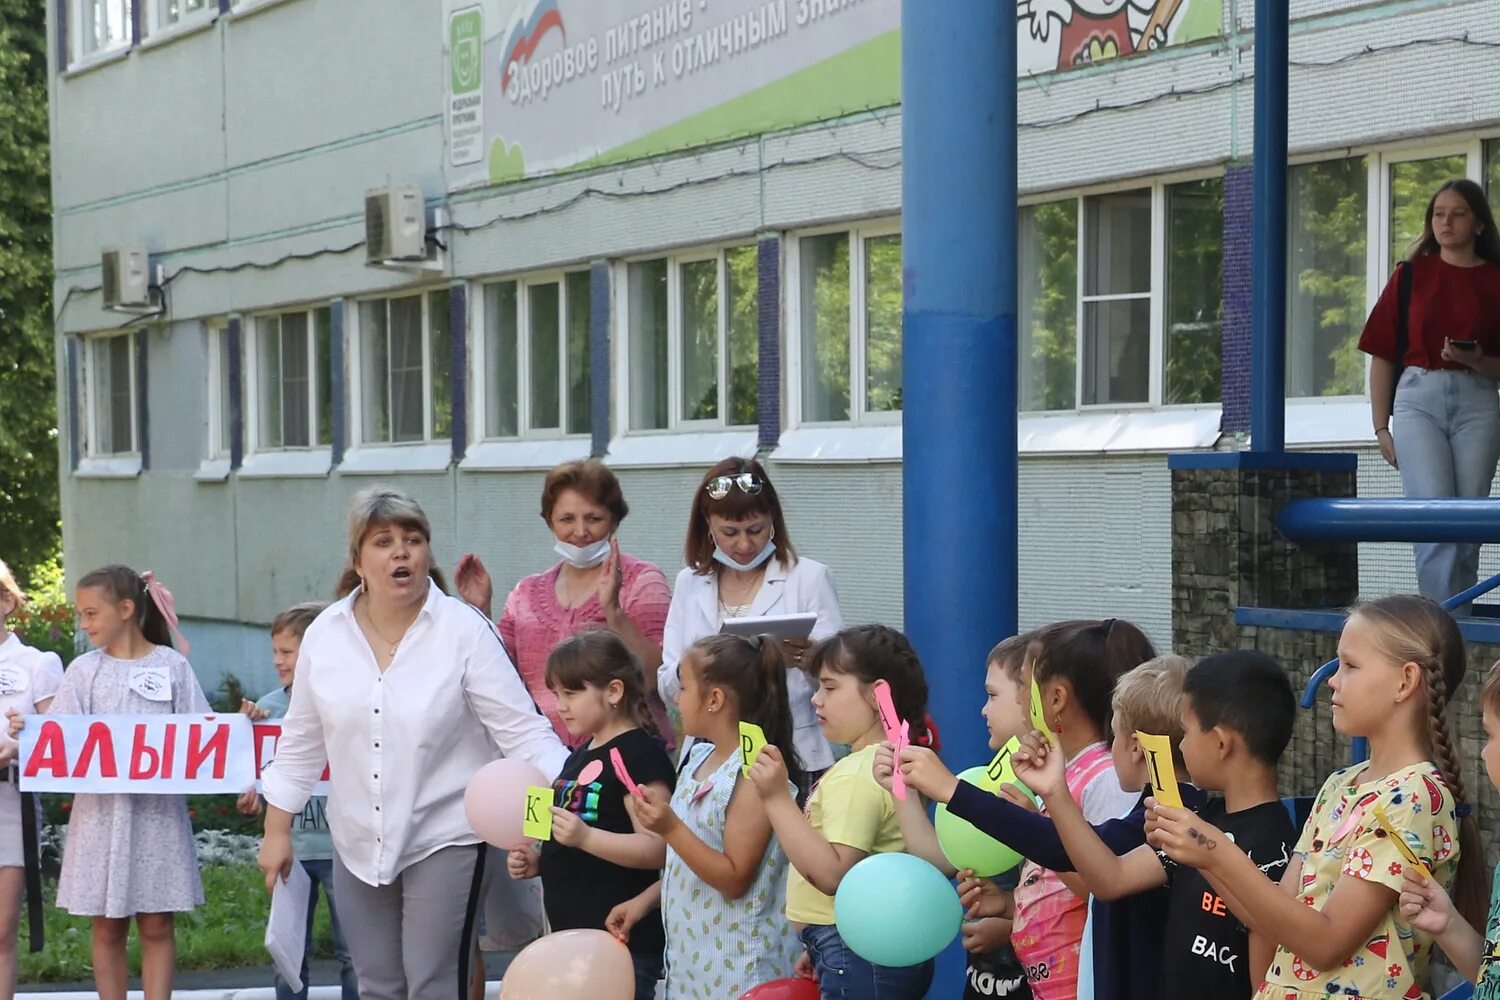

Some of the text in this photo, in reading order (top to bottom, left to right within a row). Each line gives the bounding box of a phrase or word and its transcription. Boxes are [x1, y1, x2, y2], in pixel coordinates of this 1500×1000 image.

[507, 37, 599, 104] Здоровое
[606, 0, 692, 62] питание
[601, 61, 646, 113] путь
[672, 0, 788, 77] отличным
[23, 716, 230, 780] АЛЫЙ
[741, 734, 754, 766] Р
[525, 795, 541, 823] К
[1191, 935, 1238, 973] BACK
